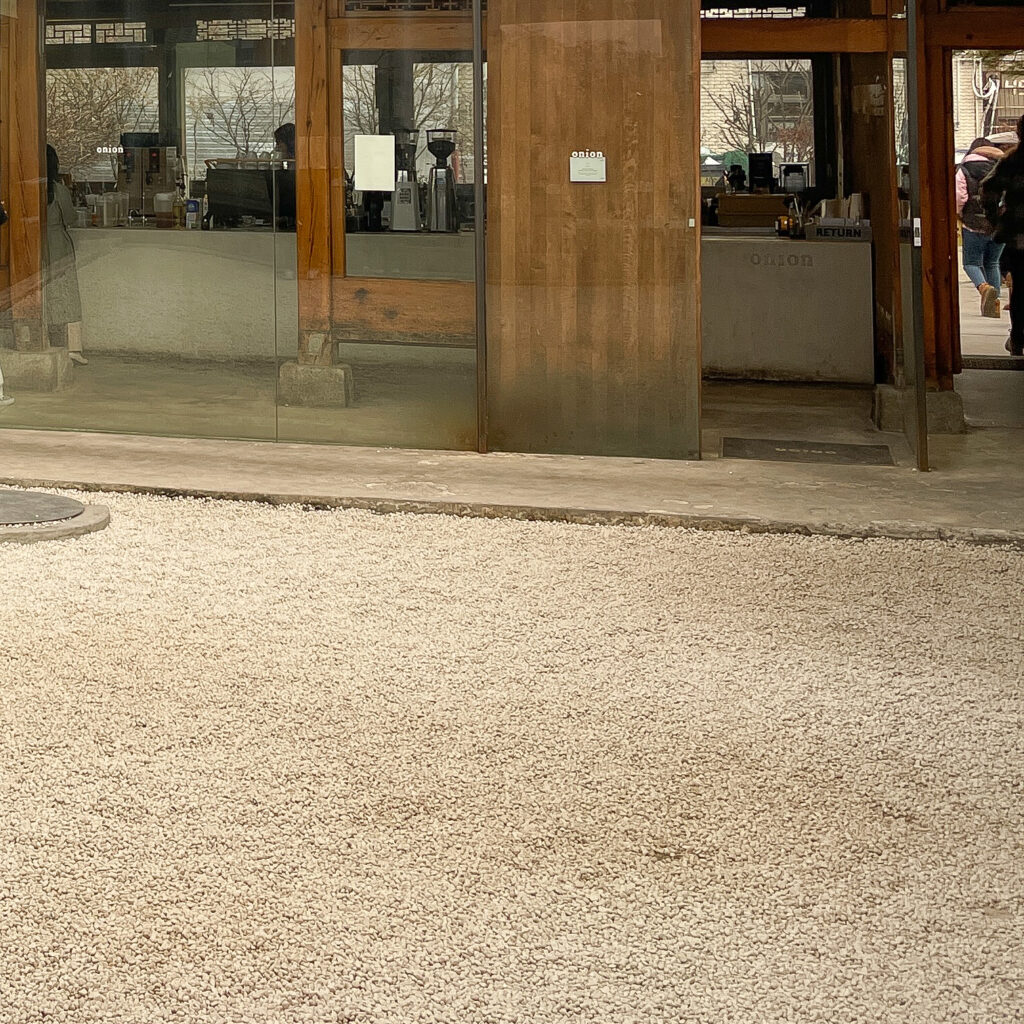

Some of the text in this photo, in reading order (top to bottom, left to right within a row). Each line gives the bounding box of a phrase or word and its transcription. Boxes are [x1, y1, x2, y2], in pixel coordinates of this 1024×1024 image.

[96, 144, 124, 154] onion
[571, 148, 603, 158] onion
[816, 227, 862, 238] RETURN
[750, 252, 813, 267] onion
